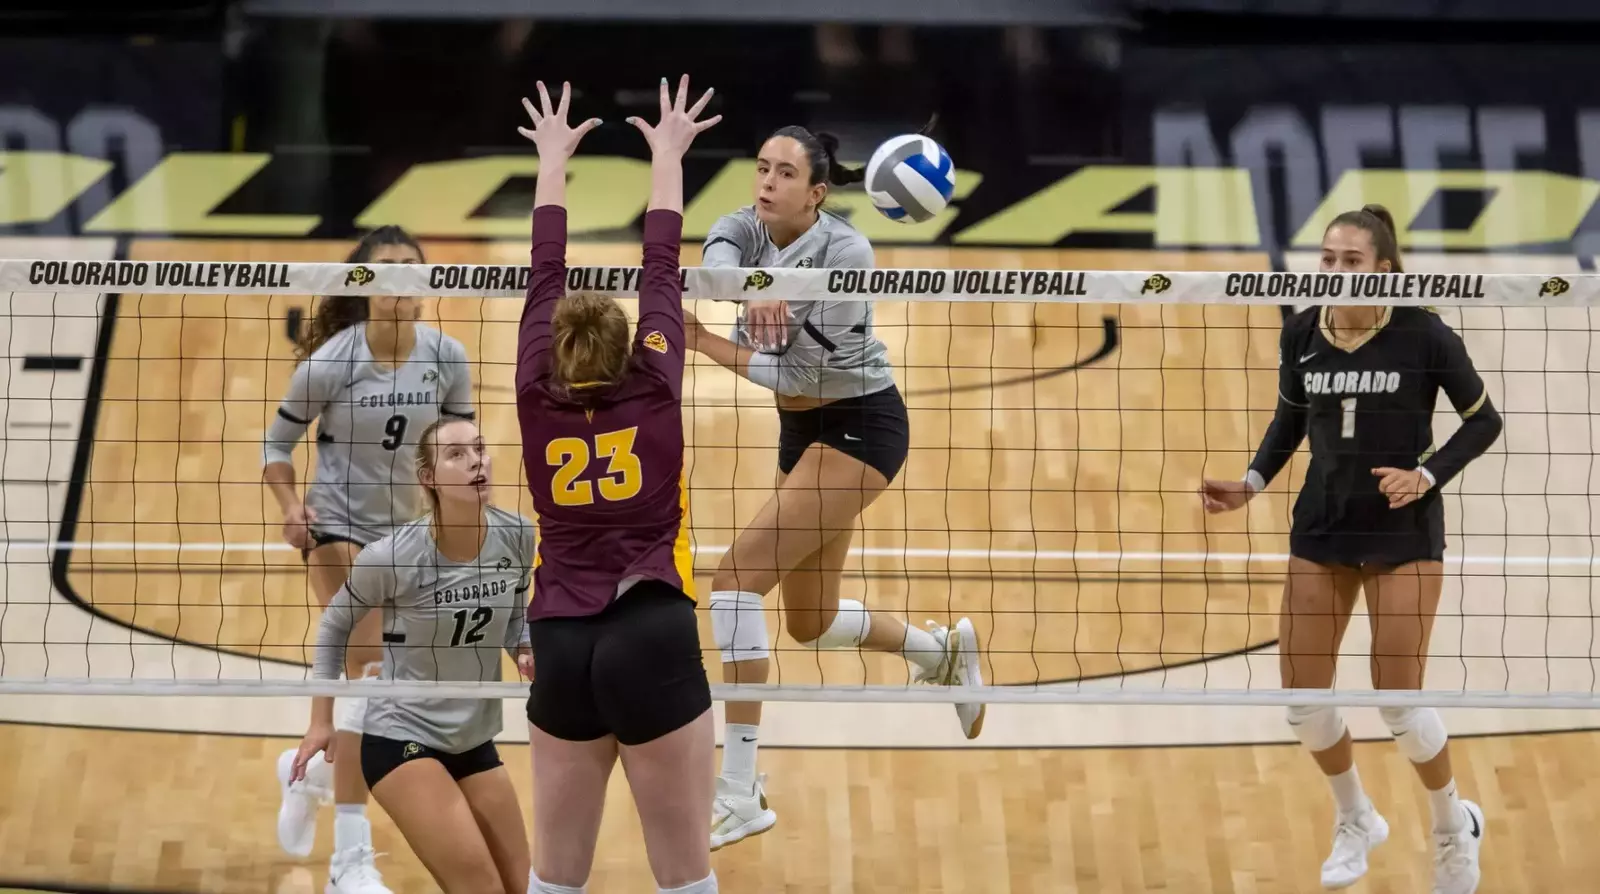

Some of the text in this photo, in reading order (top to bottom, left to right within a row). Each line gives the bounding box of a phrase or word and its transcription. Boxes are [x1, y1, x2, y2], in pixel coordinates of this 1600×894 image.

[29, 261, 291, 288] COLORADO VOLLEYBALL
[429, 266, 531, 291] COLORAD
[827, 270, 1087, 296] COLORADO VOLLEYBALL
[1225, 273, 1485, 299] COLORADO VOLLEYBALL
[1304, 371, 1401, 394] COLORADO
[360, 391, 431, 408] COLORADO
[1341, 398, 1358, 438] 1
[381, 414, 409, 451] 9
[546, 426, 643, 506] 23
[434, 579, 507, 605] COLORADO
[450, 606, 494, 647] 12
